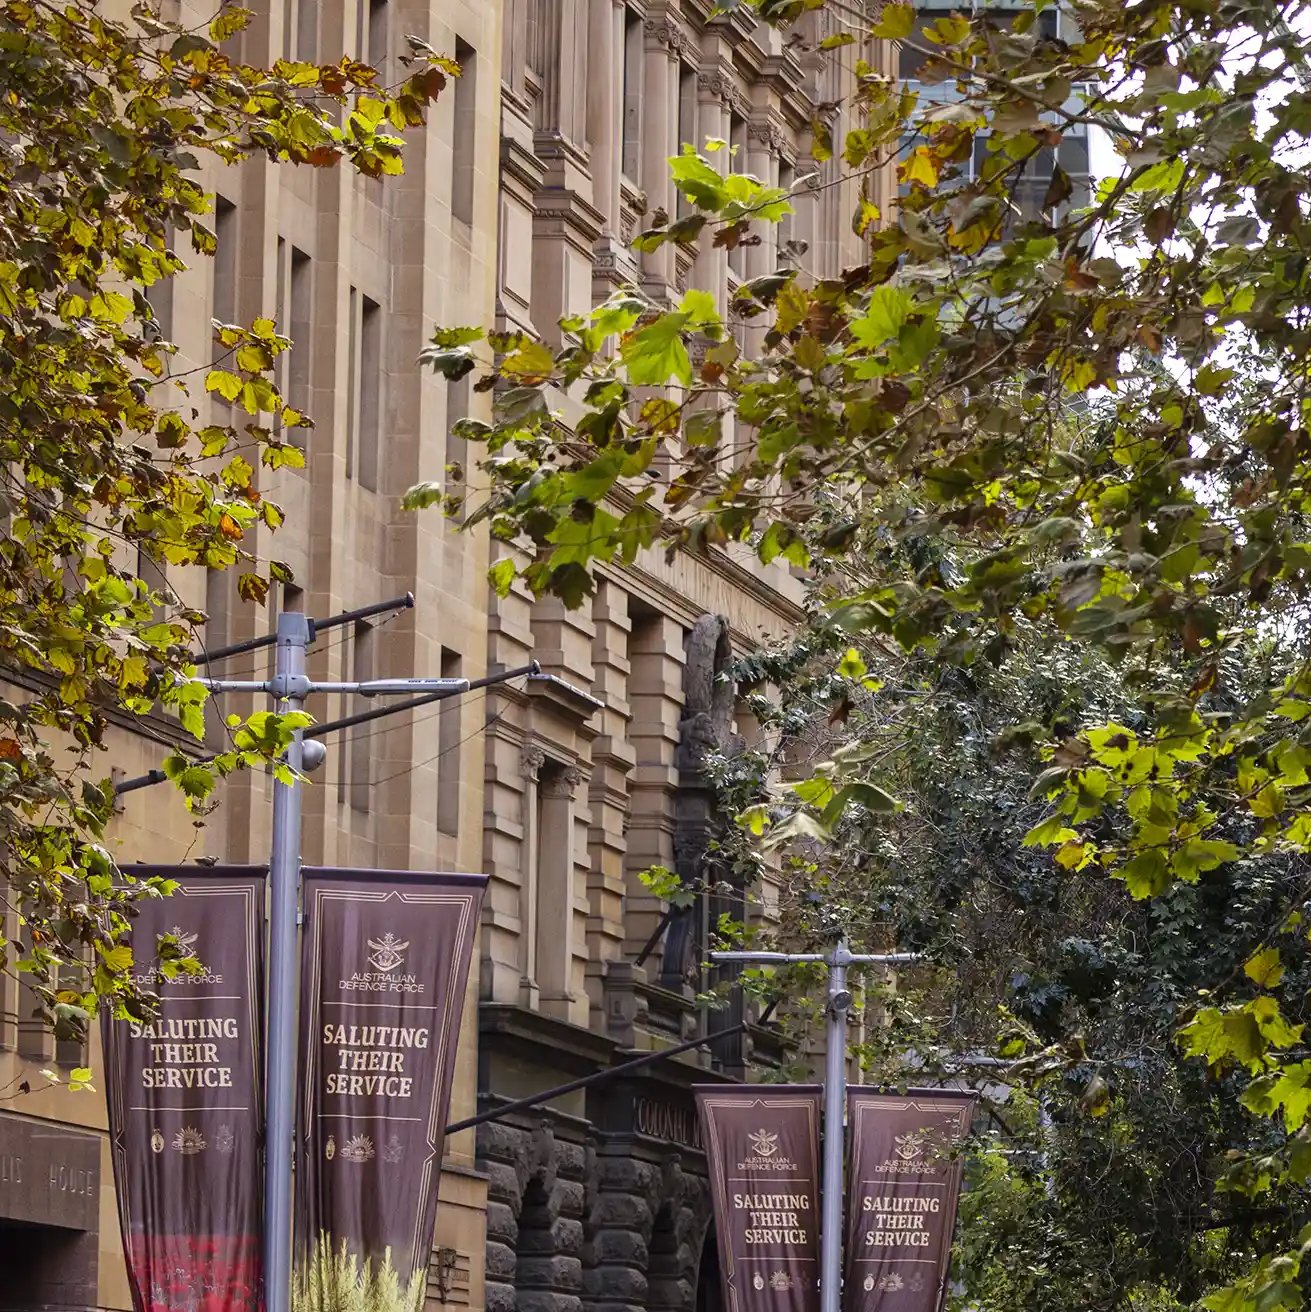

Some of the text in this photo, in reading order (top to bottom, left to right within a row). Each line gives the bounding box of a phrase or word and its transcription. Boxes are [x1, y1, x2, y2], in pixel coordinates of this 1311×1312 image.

[137, 975, 223, 985] DEFNCE FORCE
[351, 973, 416, 984] AUSTRALIAN
[339, 981, 424, 993] DEFENCE FORCE
[130, 1018, 239, 1039] SALUTING
[323, 1024, 429, 1048] SALUTING
[151, 1043, 219, 1064] THEIR
[338, 1050, 404, 1072] THEIR
[142, 1067, 233, 1088] SERVICE
[326, 1073, 413, 1097] SERVICE
[875, 1165, 910, 1173] DEFENCE
[884, 1159, 929, 1167] AUSTRALIAN
[49, 1163, 93, 1196] HOUSE
[733, 1193, 809, 1209] SALUTING
[863, 1196, 940, 1212] SALUTING
[750, 1211, 799, 1227] THEIR
[876, 1214, 923, 1229] THEIR
[745, 1229, 808, 1244] SERVICE
[865, 1231, 930, 1246] SERVICE
